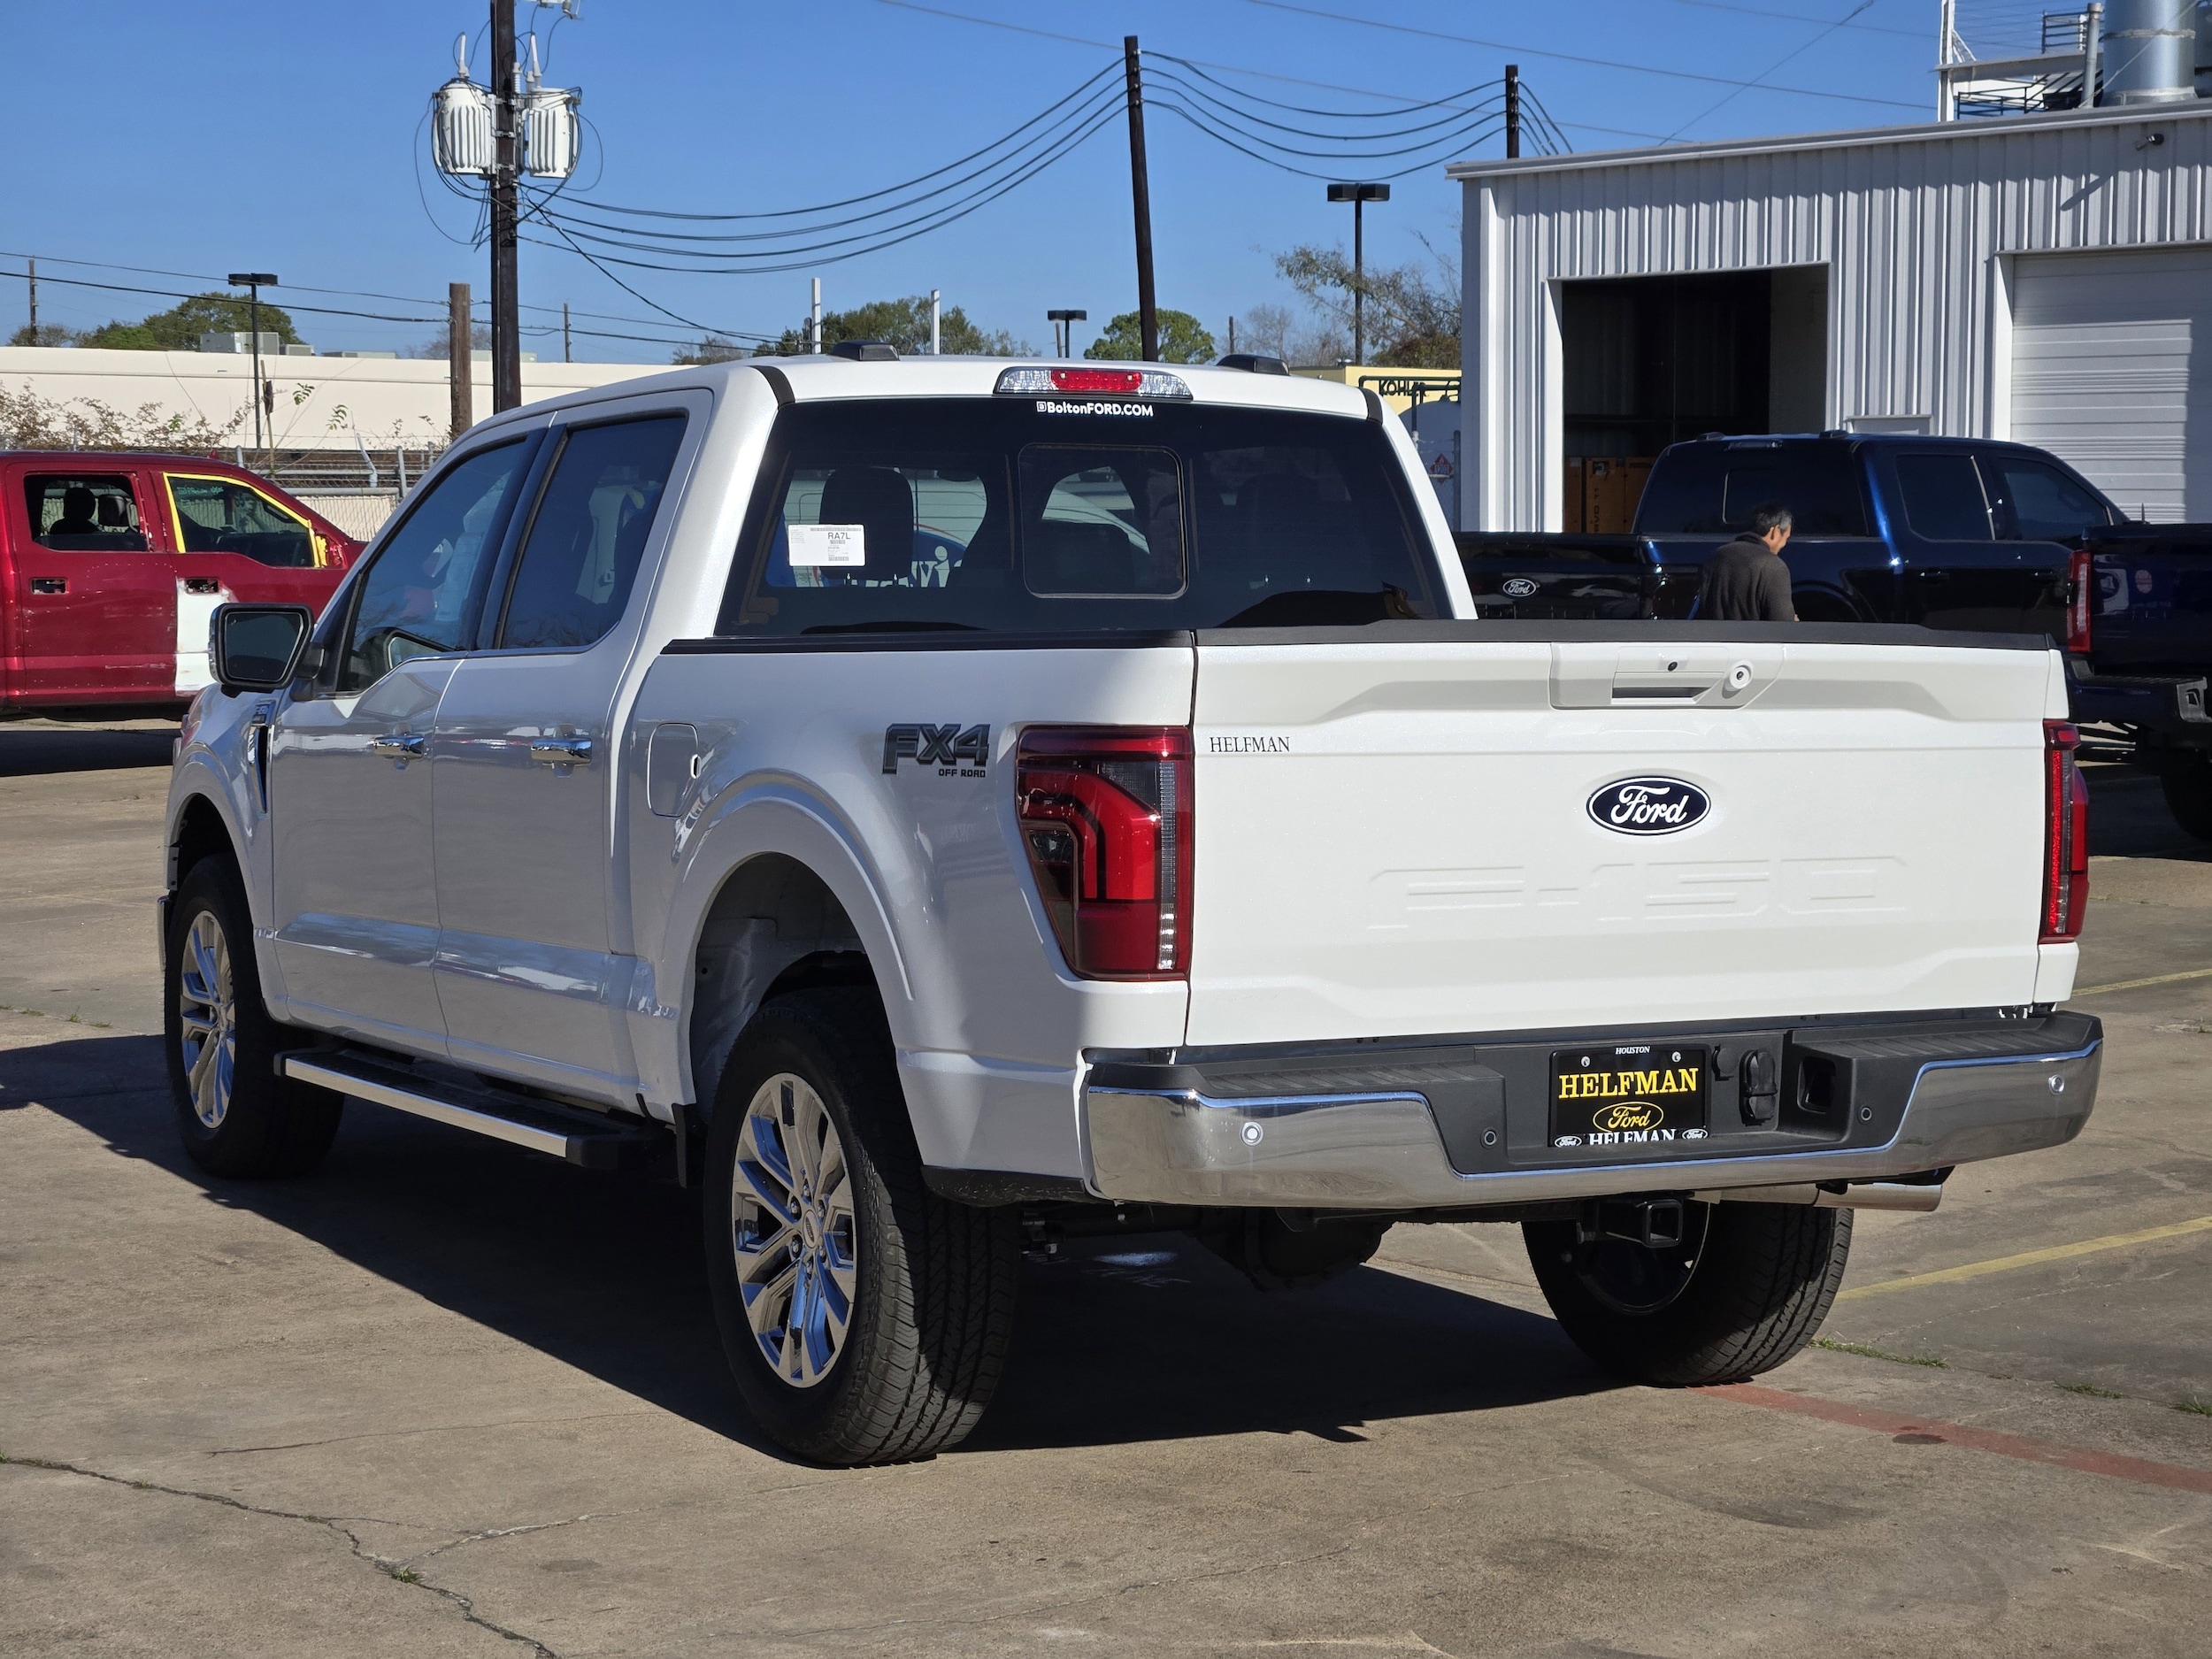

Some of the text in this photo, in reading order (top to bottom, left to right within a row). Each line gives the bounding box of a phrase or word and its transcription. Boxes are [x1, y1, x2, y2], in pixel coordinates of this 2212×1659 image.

[1508, 580, 1531, 594] Ford
[882, 723, 991, 774] FX4
[1209, 736, 1290, 753] HELFMAN
[939, 768, 987, 778] OFF ROAD
[1610, 785, 1690, 824] Ford
[1615, 1046, 1651, 1055] HOUSTON
[1558, 1067, 1699, 1099] HELFMAN
[1608, 1106, 1652, 1129] Ford
